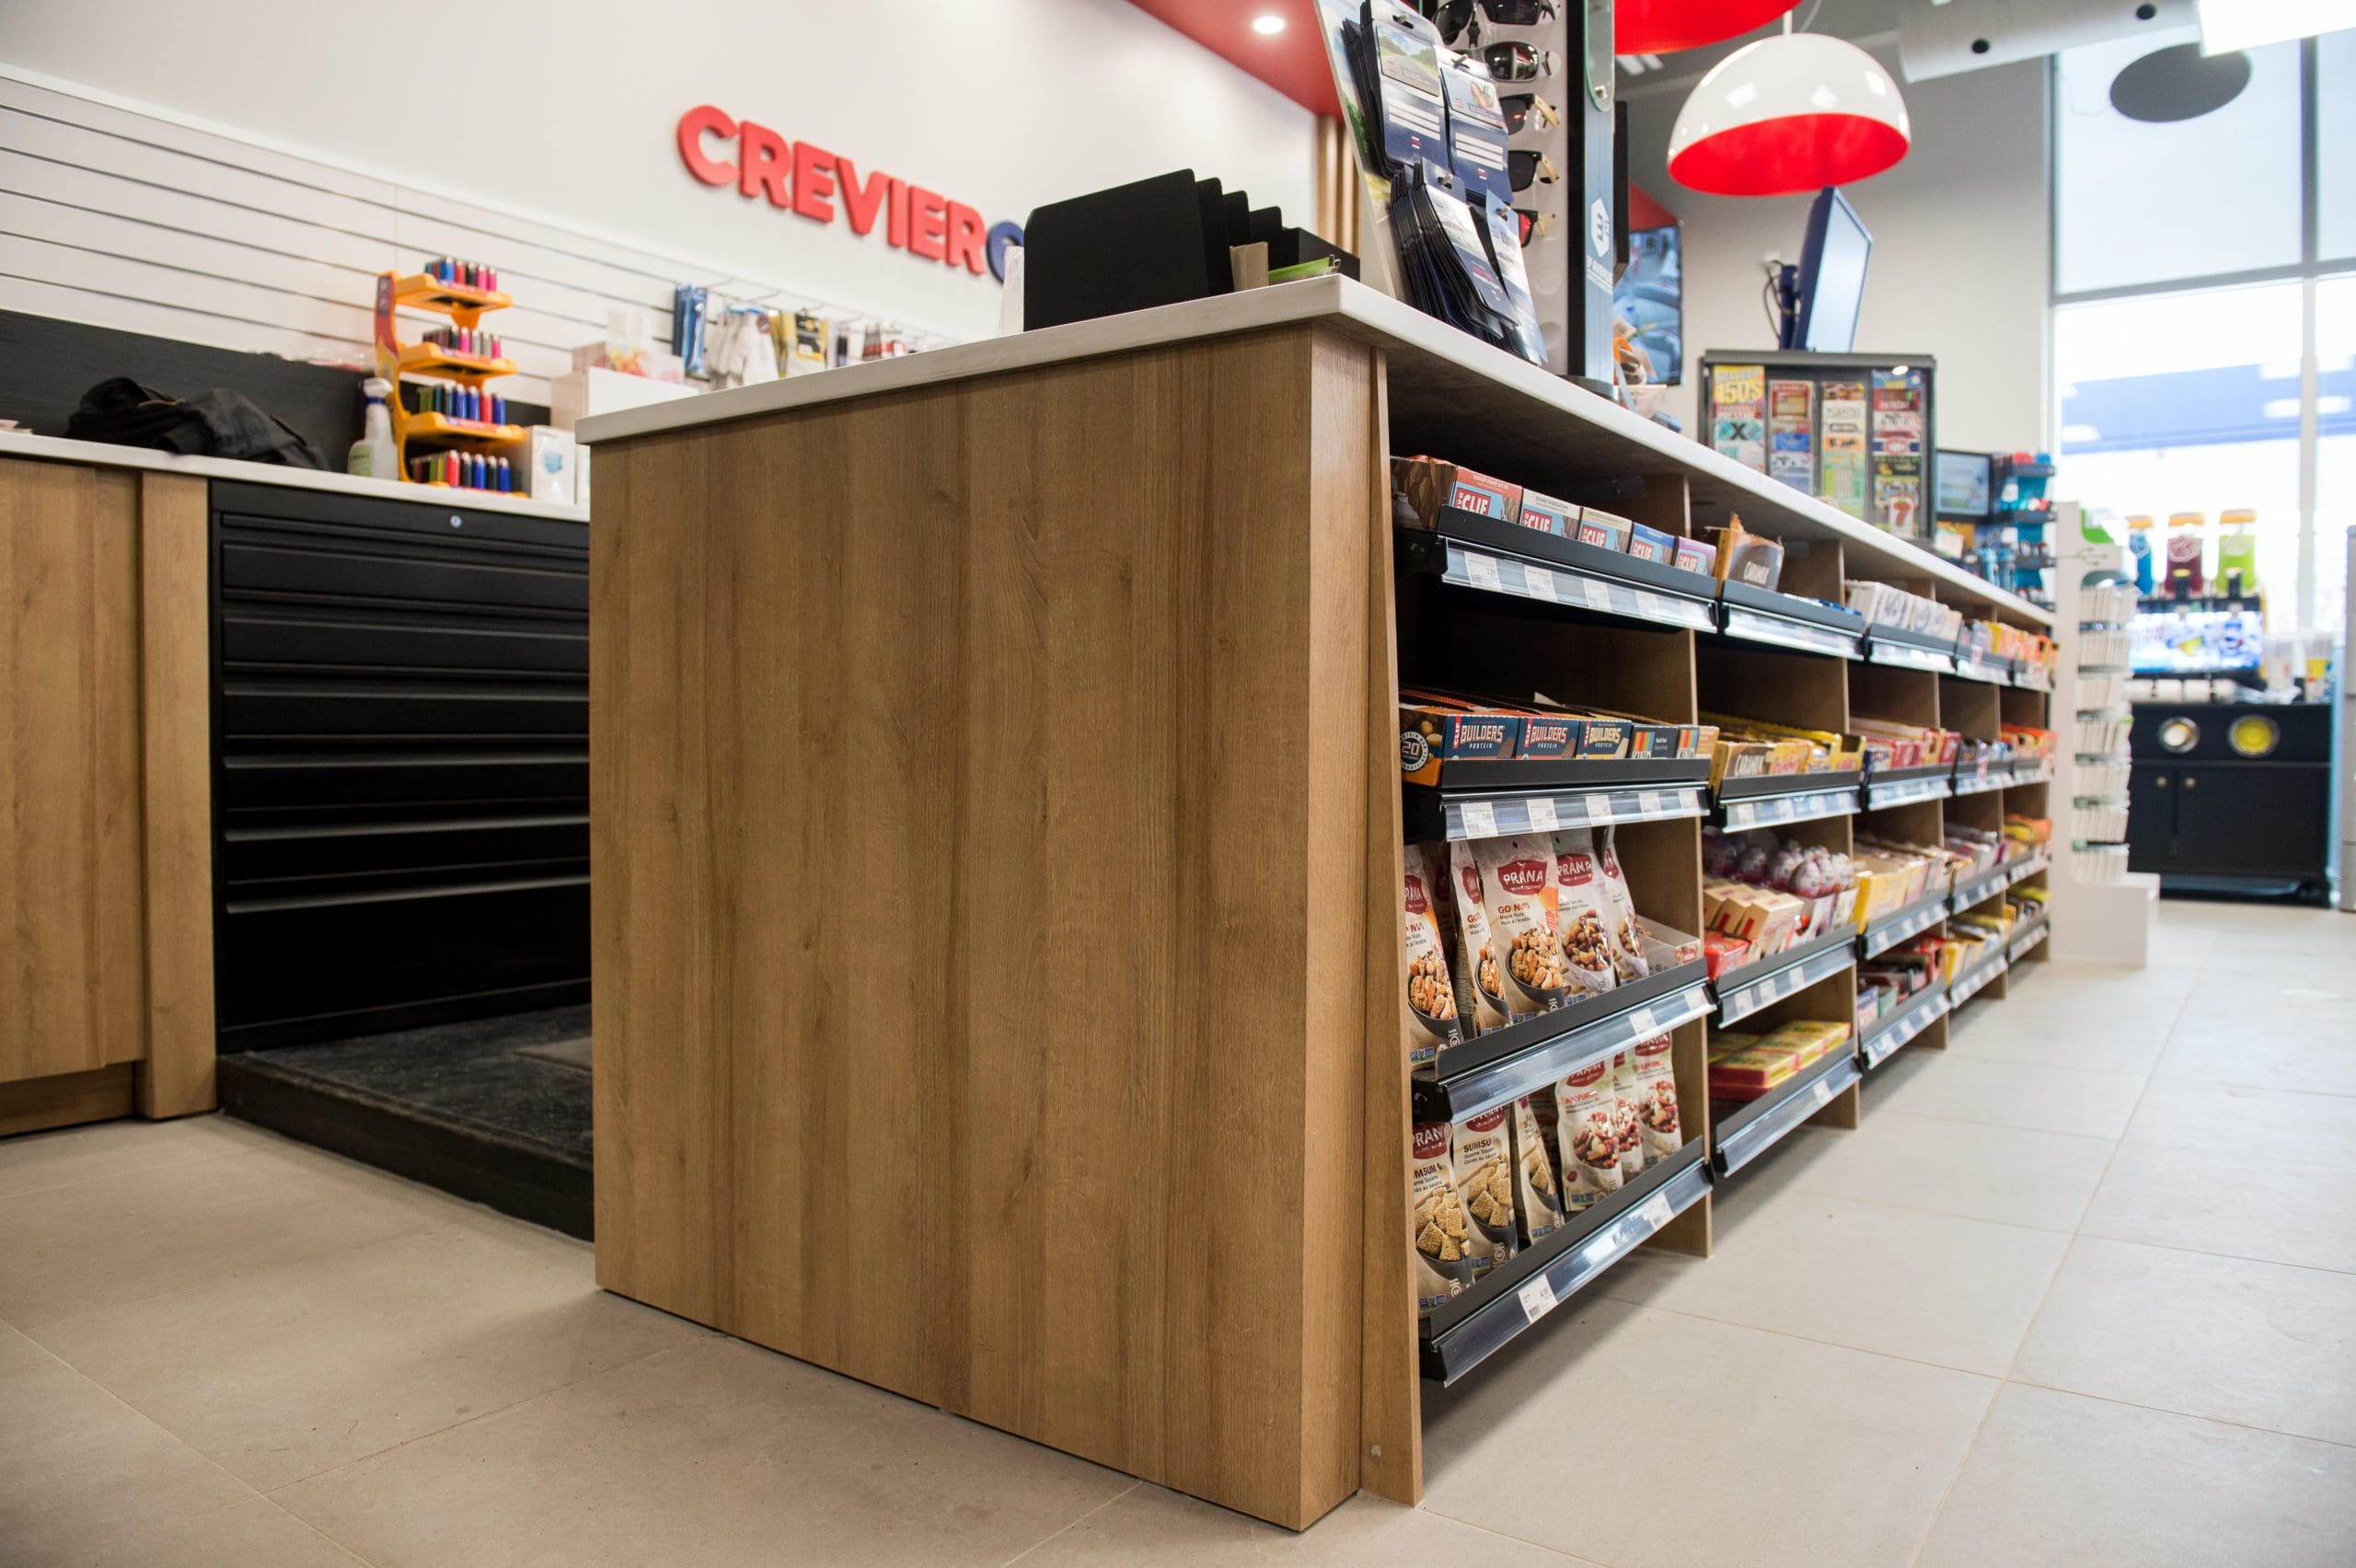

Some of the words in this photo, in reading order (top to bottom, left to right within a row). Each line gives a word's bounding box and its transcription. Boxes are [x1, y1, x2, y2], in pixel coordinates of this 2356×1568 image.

[677, 105, 987, 275] CREVIER
[1461, 493, 1489, 515] CLIF
[1528, 514, 1551, 532] CLIF
[1586, 528, 1606, 548] CLIF
[1460, 724, 1504, 744] BUILDERS
[1530, 726, 1567, 744] BUILDERS
[1589, 727, 1621, 744] BUILDERS
[1503, 870, 1543, 884] PRANA
[1557, 860, 1591, 876] PRANA
[1498, 904, 1511, 914] GO
[1414, 1125, 1445, 1147] RAN
[1463, 1136, 1496, 1153] SUMSU
